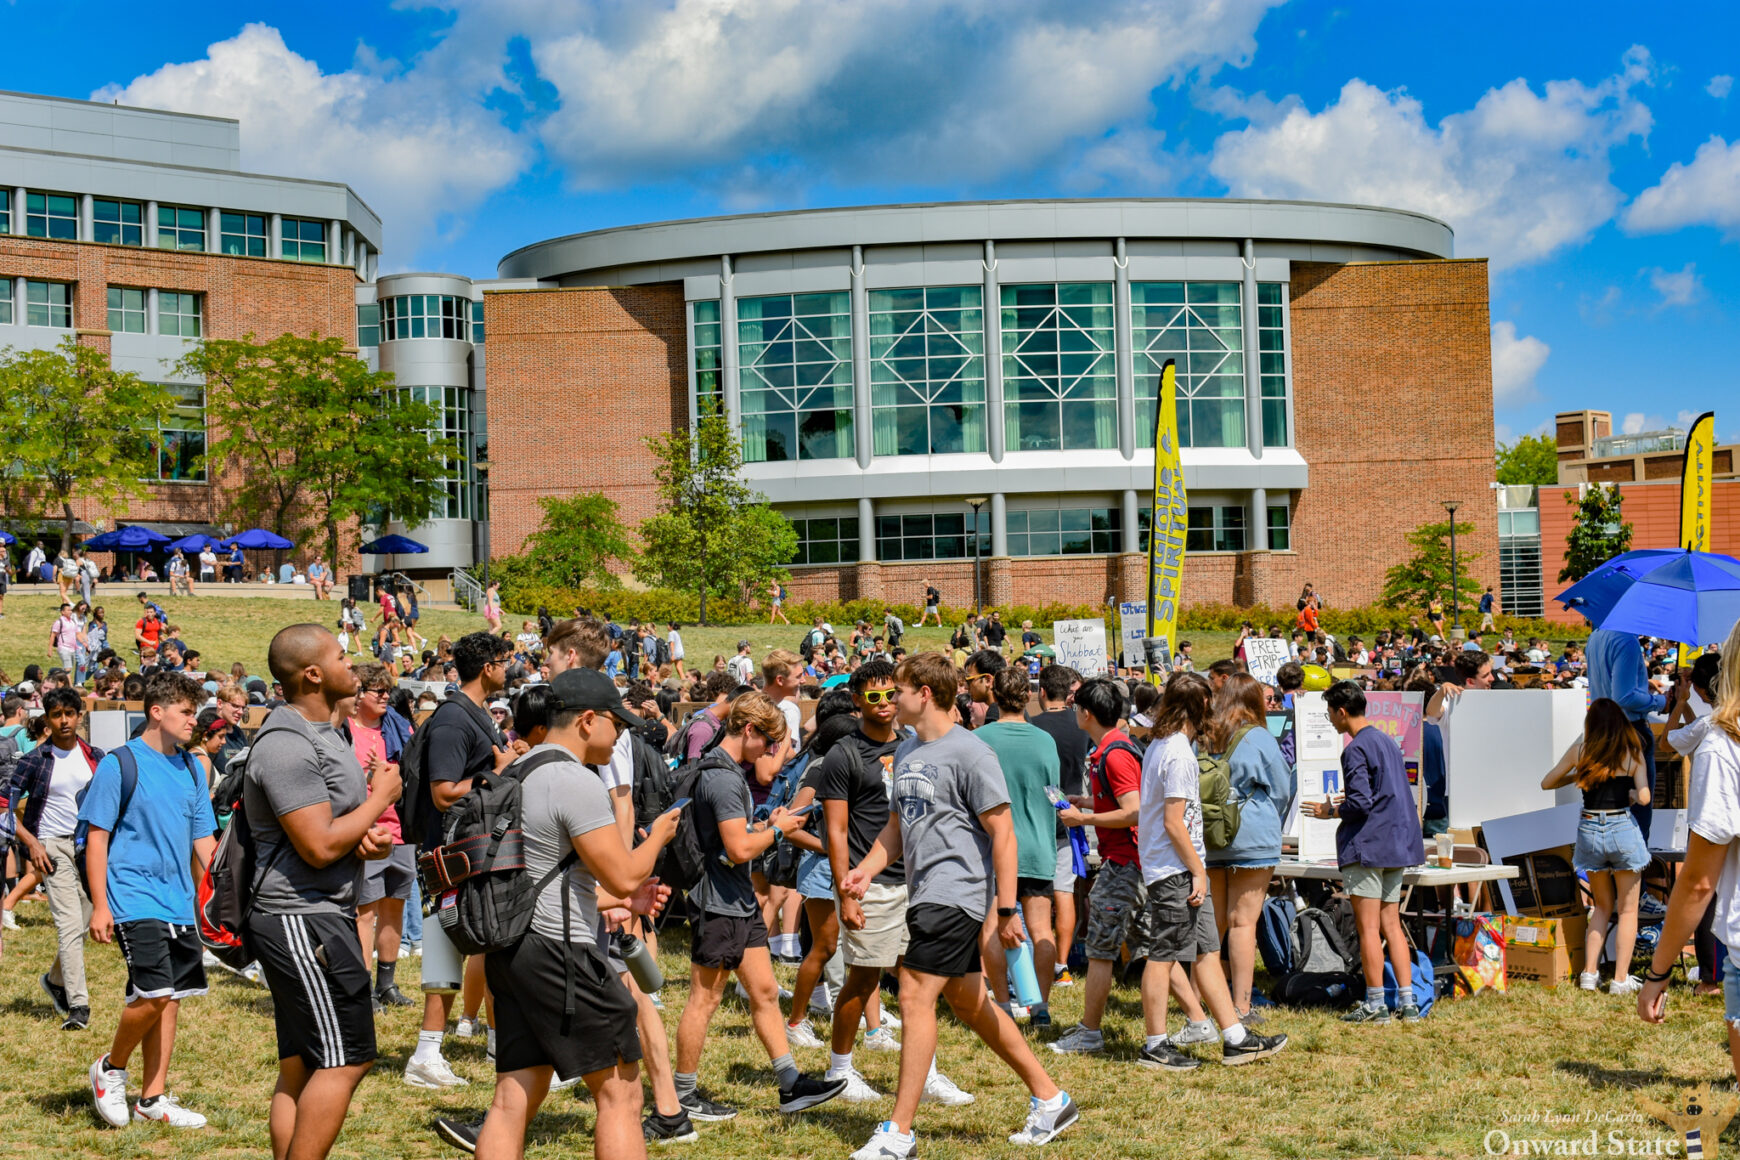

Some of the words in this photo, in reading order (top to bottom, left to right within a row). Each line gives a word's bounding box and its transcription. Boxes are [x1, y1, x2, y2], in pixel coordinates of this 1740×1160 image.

[1155, 466, 1172, 596] IGIOUS
[1156, 461, 1187, 623] SPIRITUAL
[1059, 623, 1079, 634] What
[1082, 625, 1094, 633] are
[1058, 640, 1102, 664] Shabbat
[1250, 640, 1280, 655] FREE
[1255, 653, 1278, 670] TRIP
[1365, 701, 1420, 728] UDENTS
